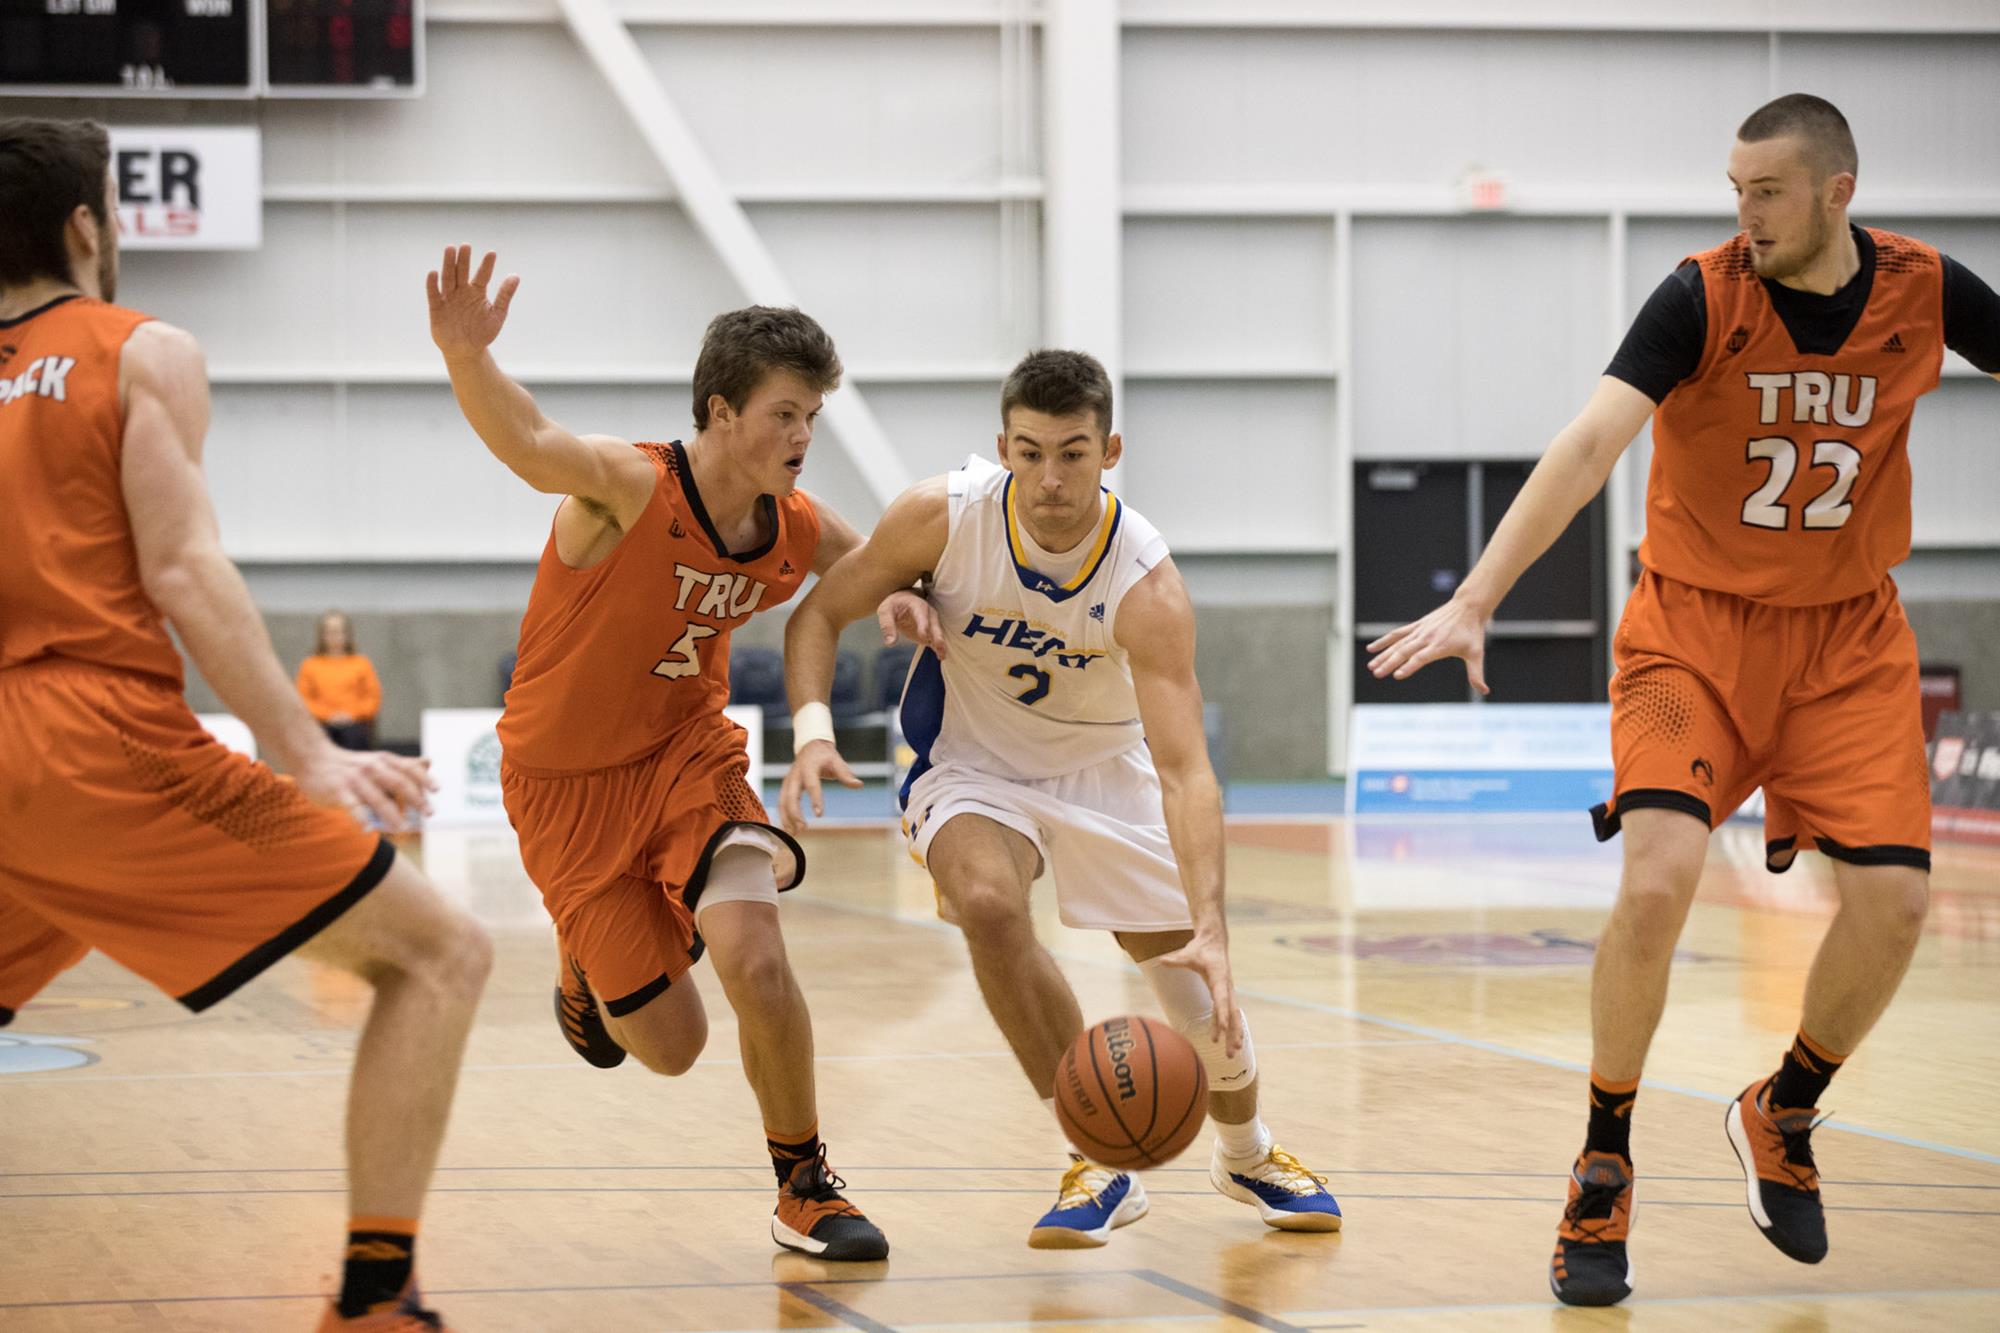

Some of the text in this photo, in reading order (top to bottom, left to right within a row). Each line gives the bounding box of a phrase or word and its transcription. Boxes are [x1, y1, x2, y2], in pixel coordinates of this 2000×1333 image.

[1745, 370, 1878, 428] TRU
[1741, 436, 1863, 531] 22
[673, 562, 768, 619] TRU
[650, 621, 720, 681] 5
[1103, 1018, 1137, 1102] Wilson
